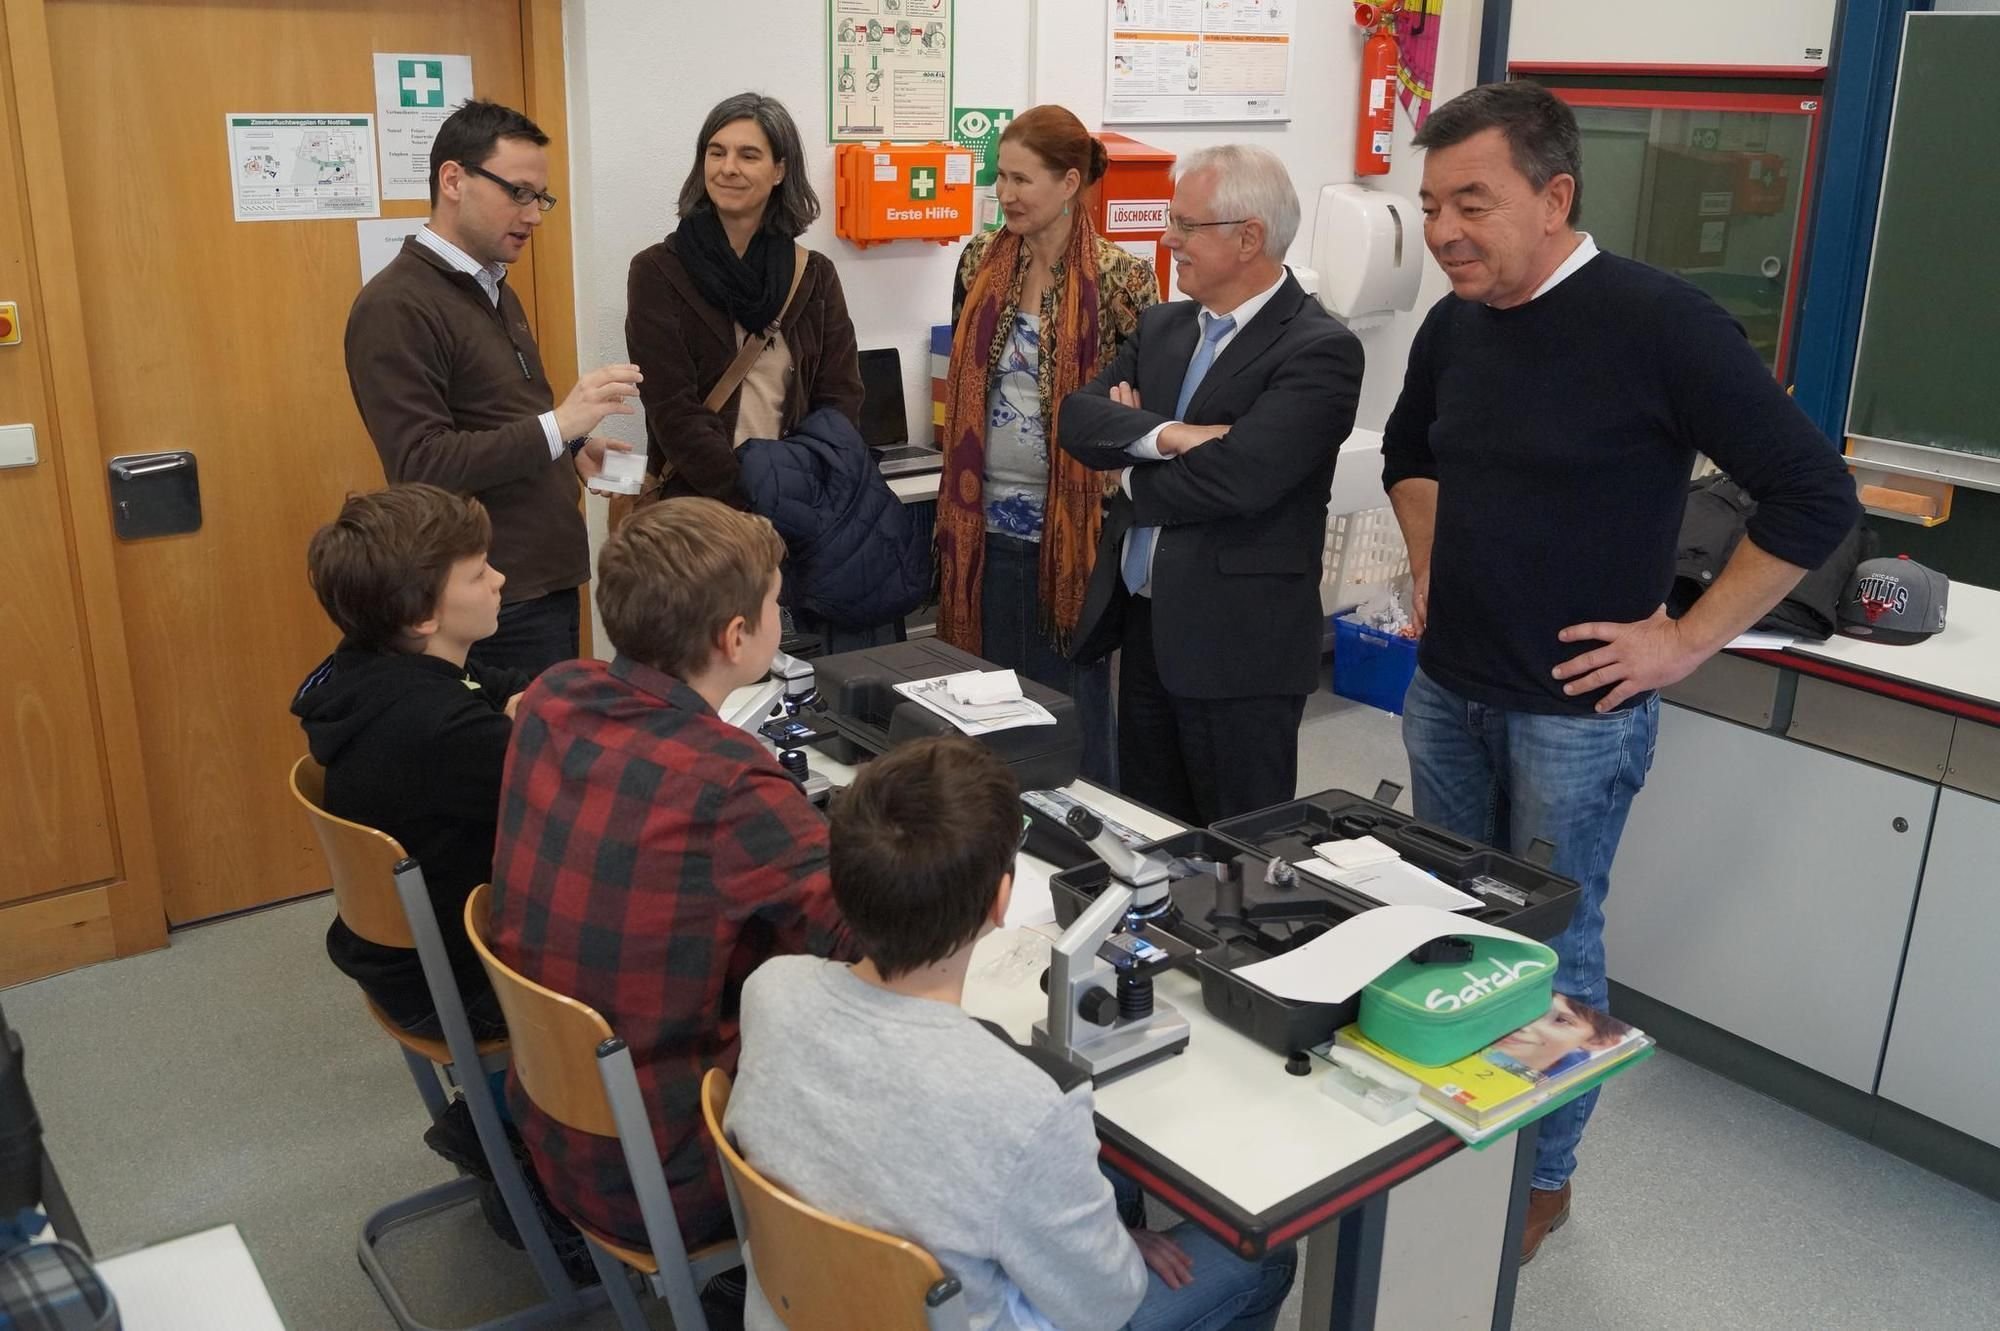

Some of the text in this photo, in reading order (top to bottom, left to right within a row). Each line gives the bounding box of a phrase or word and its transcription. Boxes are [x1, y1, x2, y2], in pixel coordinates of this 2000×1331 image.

[250, 119, 317, 127] Zimmerfluchtwegplan
[886, 207, 959, 220] Erste Hilfe
[1114, 207, 1163, 222] LÖSCHDECKE
[1872, 573, 1899, 582] CHICAGO
[1853, 577, 1909, 615] BULLS
[1476, 1070, 1494, 1080] 2
